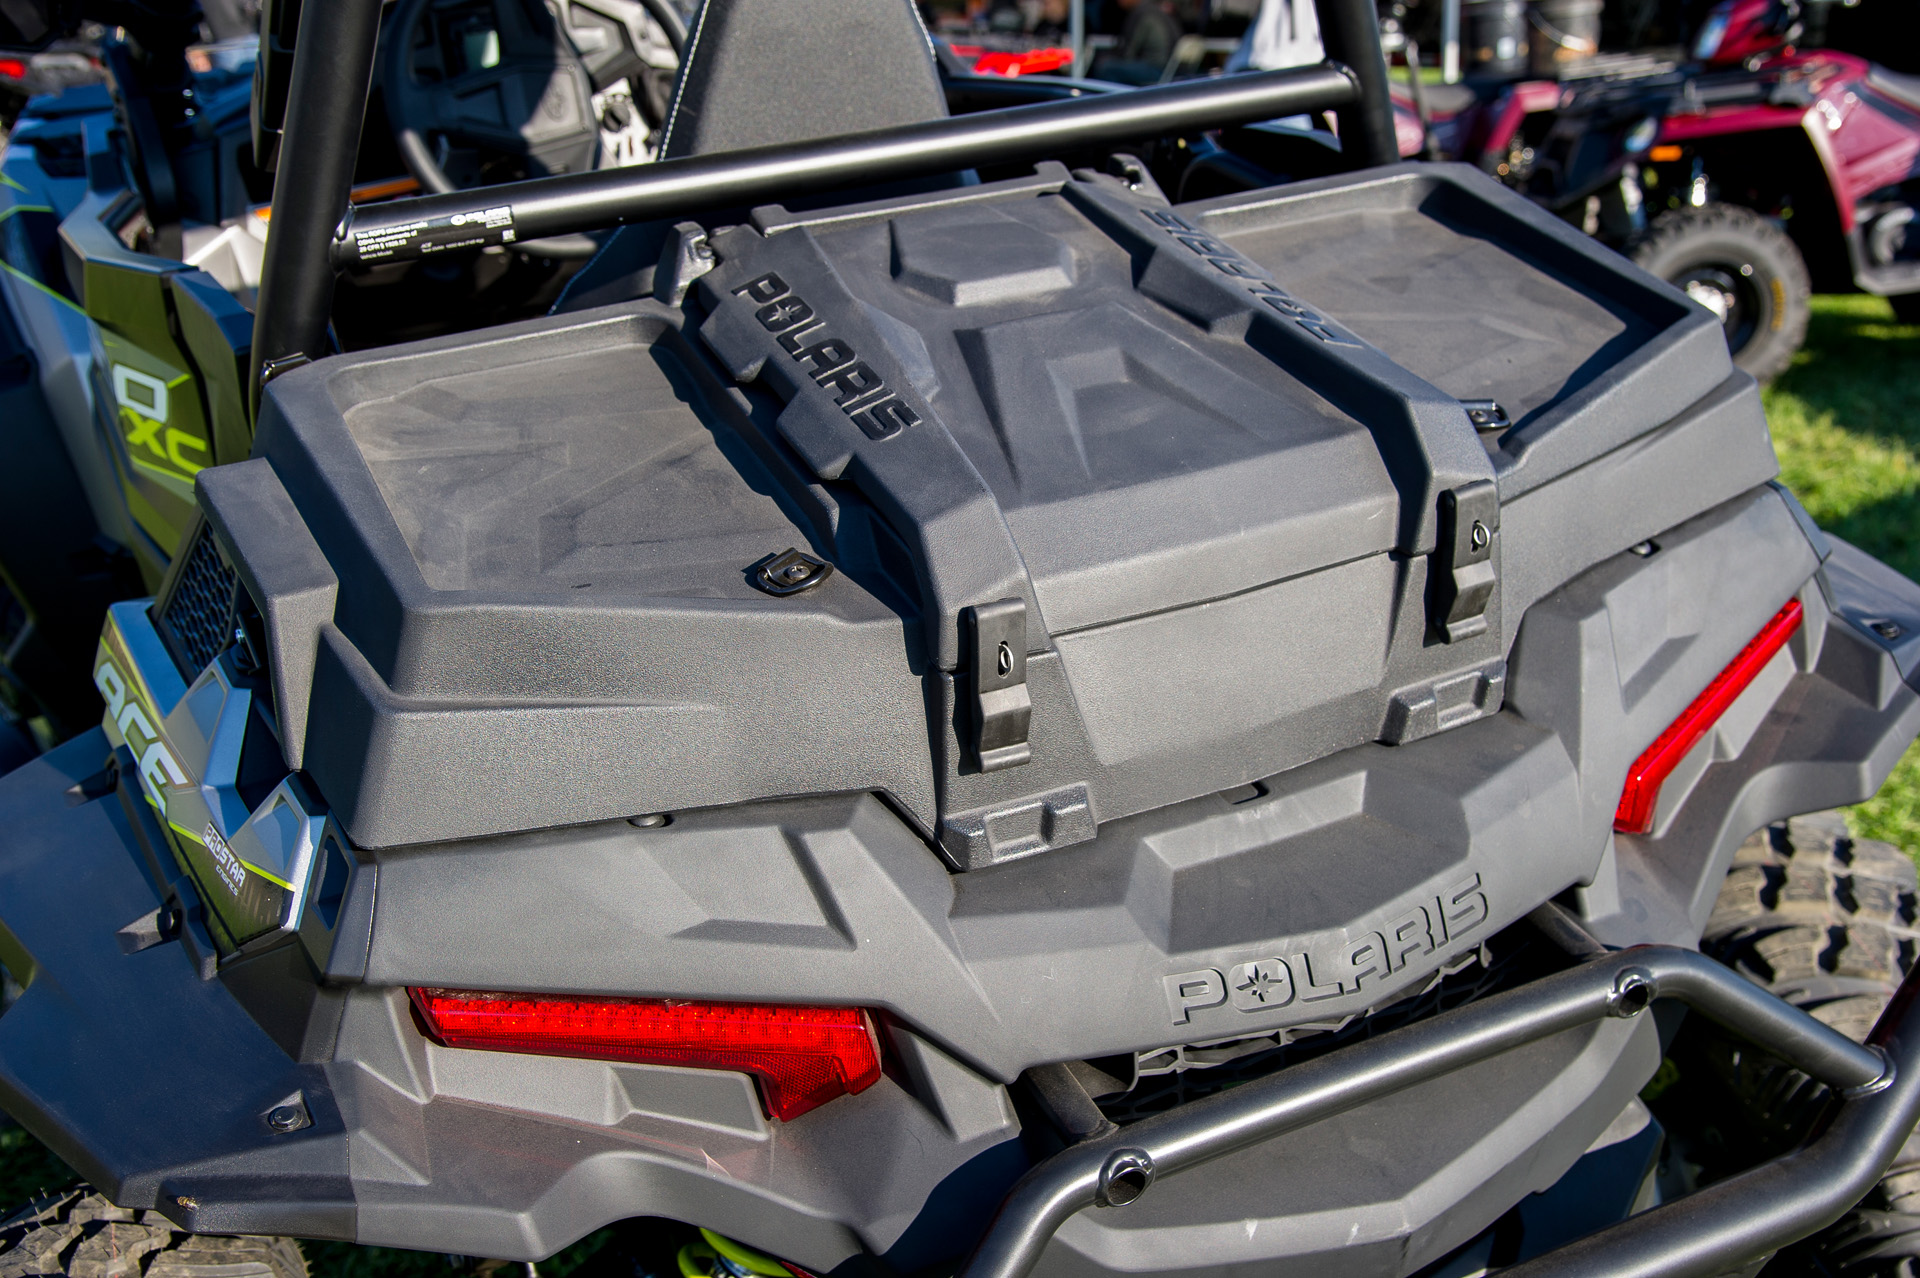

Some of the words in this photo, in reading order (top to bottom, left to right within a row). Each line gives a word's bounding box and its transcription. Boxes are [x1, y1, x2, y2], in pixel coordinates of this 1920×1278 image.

[1139, 208, 1364, 349] POLARIS
[731, 271, 923, 442] POLARIS
[119, 407, 207, 475] XC
[95, 660, 189, 819] ACE
[202, 822, 247, 888] PROSTAR
[1163, 872, 1489, 1027] POLARIS
